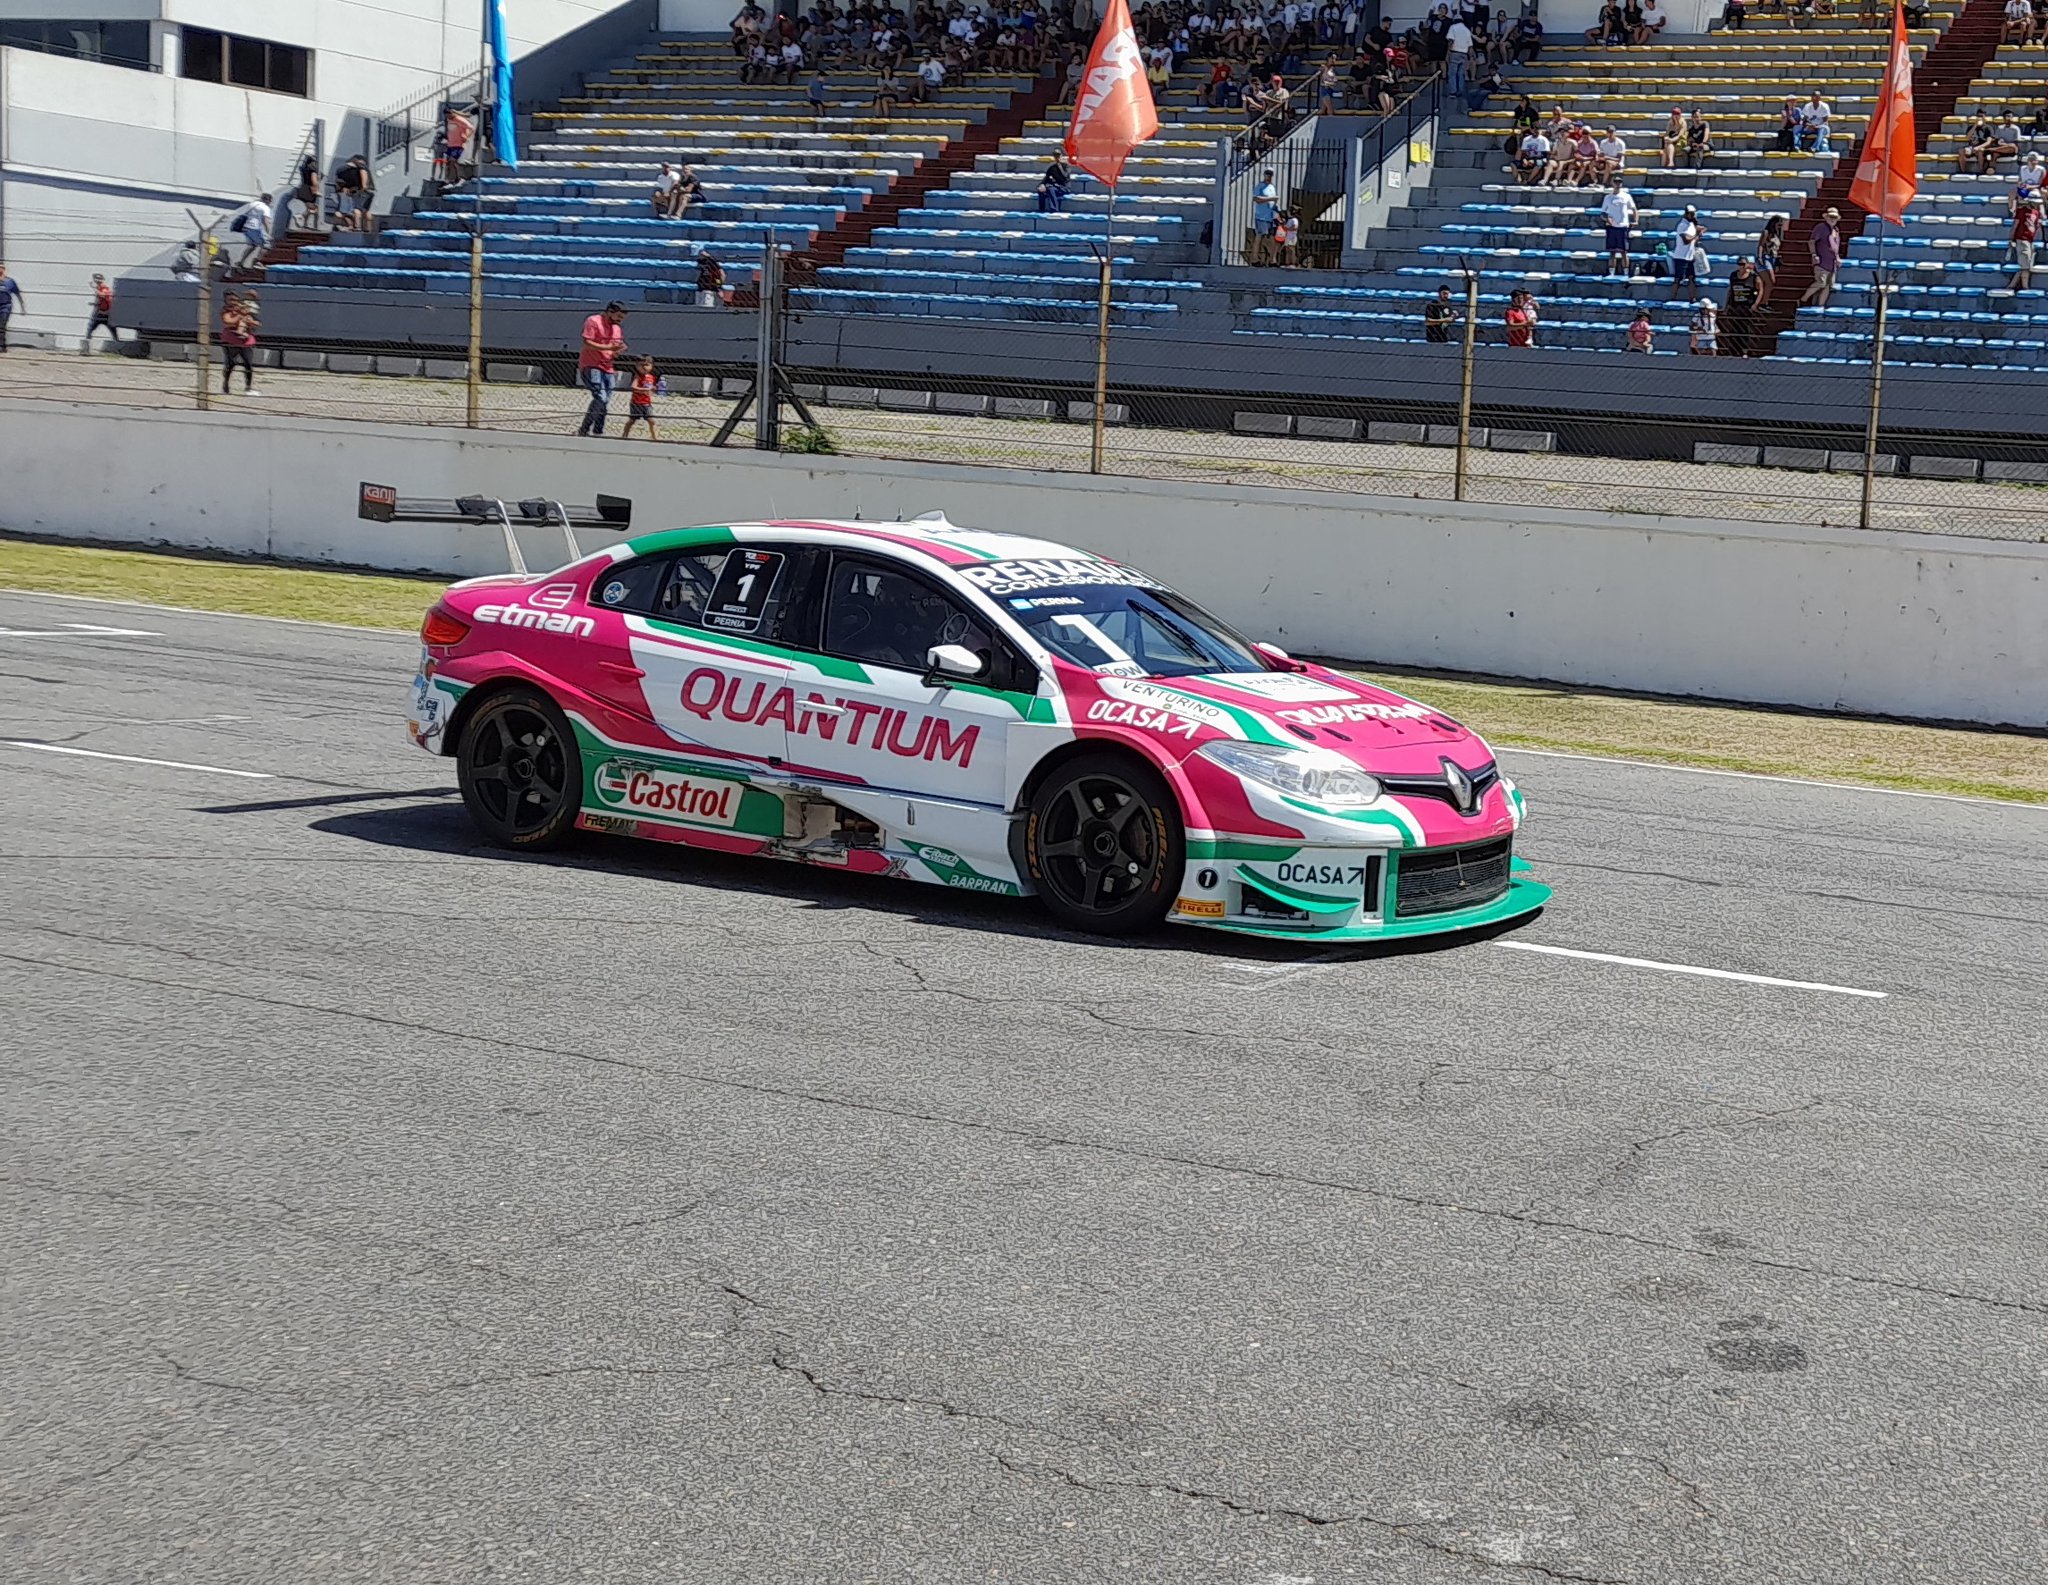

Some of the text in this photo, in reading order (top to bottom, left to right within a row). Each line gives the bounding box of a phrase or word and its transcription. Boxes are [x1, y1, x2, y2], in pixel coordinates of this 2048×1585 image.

[737, 574, 756, 602] 1
[472, 603, 596, 637] etman
[713, 616, 747, 628] PERNIA
[1122, 680, 1220, 717] VENTURINO
[680, 667, 981, 768] QUANTIUM
[629, 772, 729, 819] Castrol
[949, 874, 1009, 894] BARPRAN
[1203, 871, 1216, 887] 1
